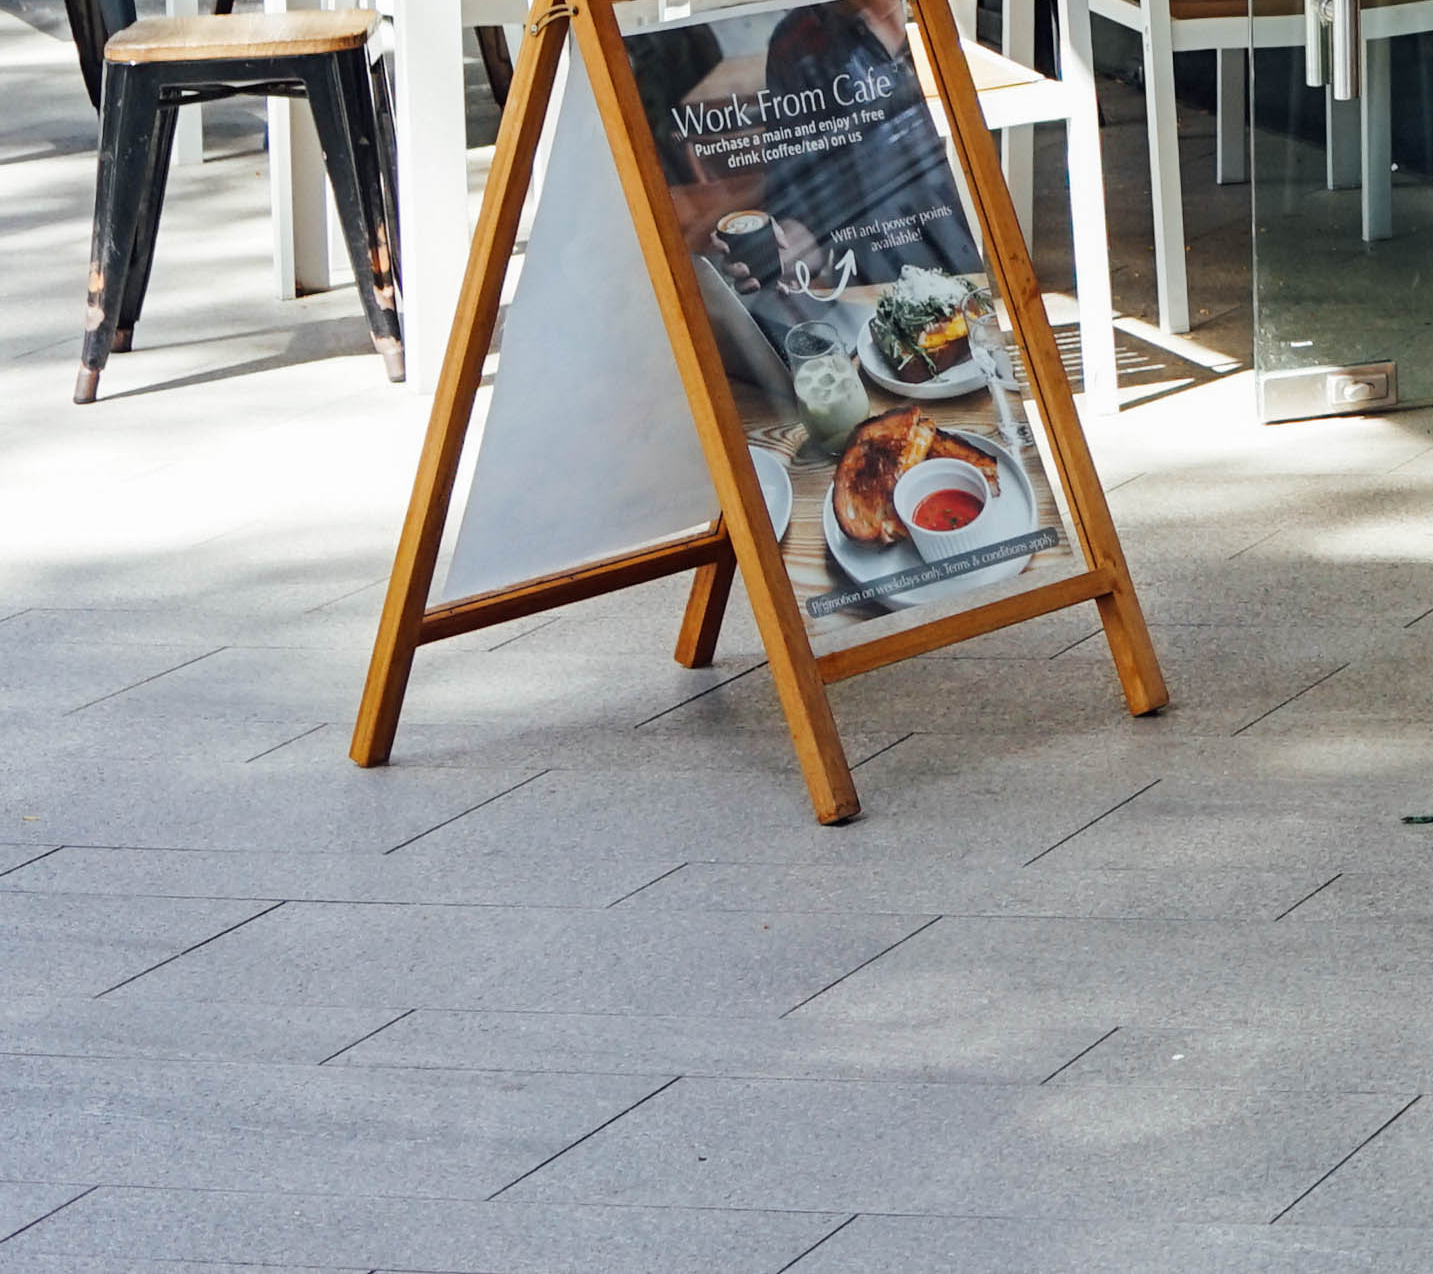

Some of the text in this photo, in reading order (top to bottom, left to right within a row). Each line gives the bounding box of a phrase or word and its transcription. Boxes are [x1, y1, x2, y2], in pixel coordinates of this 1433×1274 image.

[671, 67, 894, 139] Work From Cafe
[694, 107, 886, 158] Purchase a main and enjoy 1 free
[728, 130, 863, 169] drink (coffee/tea) on us
[860, 221, 880, 237] and
[882, 213, 918, 235] power
[920, 205, 953, 225] points
[871, 229, 923, 252] available!
[811, 591, 861, 615] Promotion
[862, 587, 875, 600] on
[876, 575, 920, 597] weekdays
[921, 567, 944, 584] only.
[945, 559, 970, 575] Terms
[981, 543, 1028, 563] conditions
[1029, 535, 1056, 553] apply.
